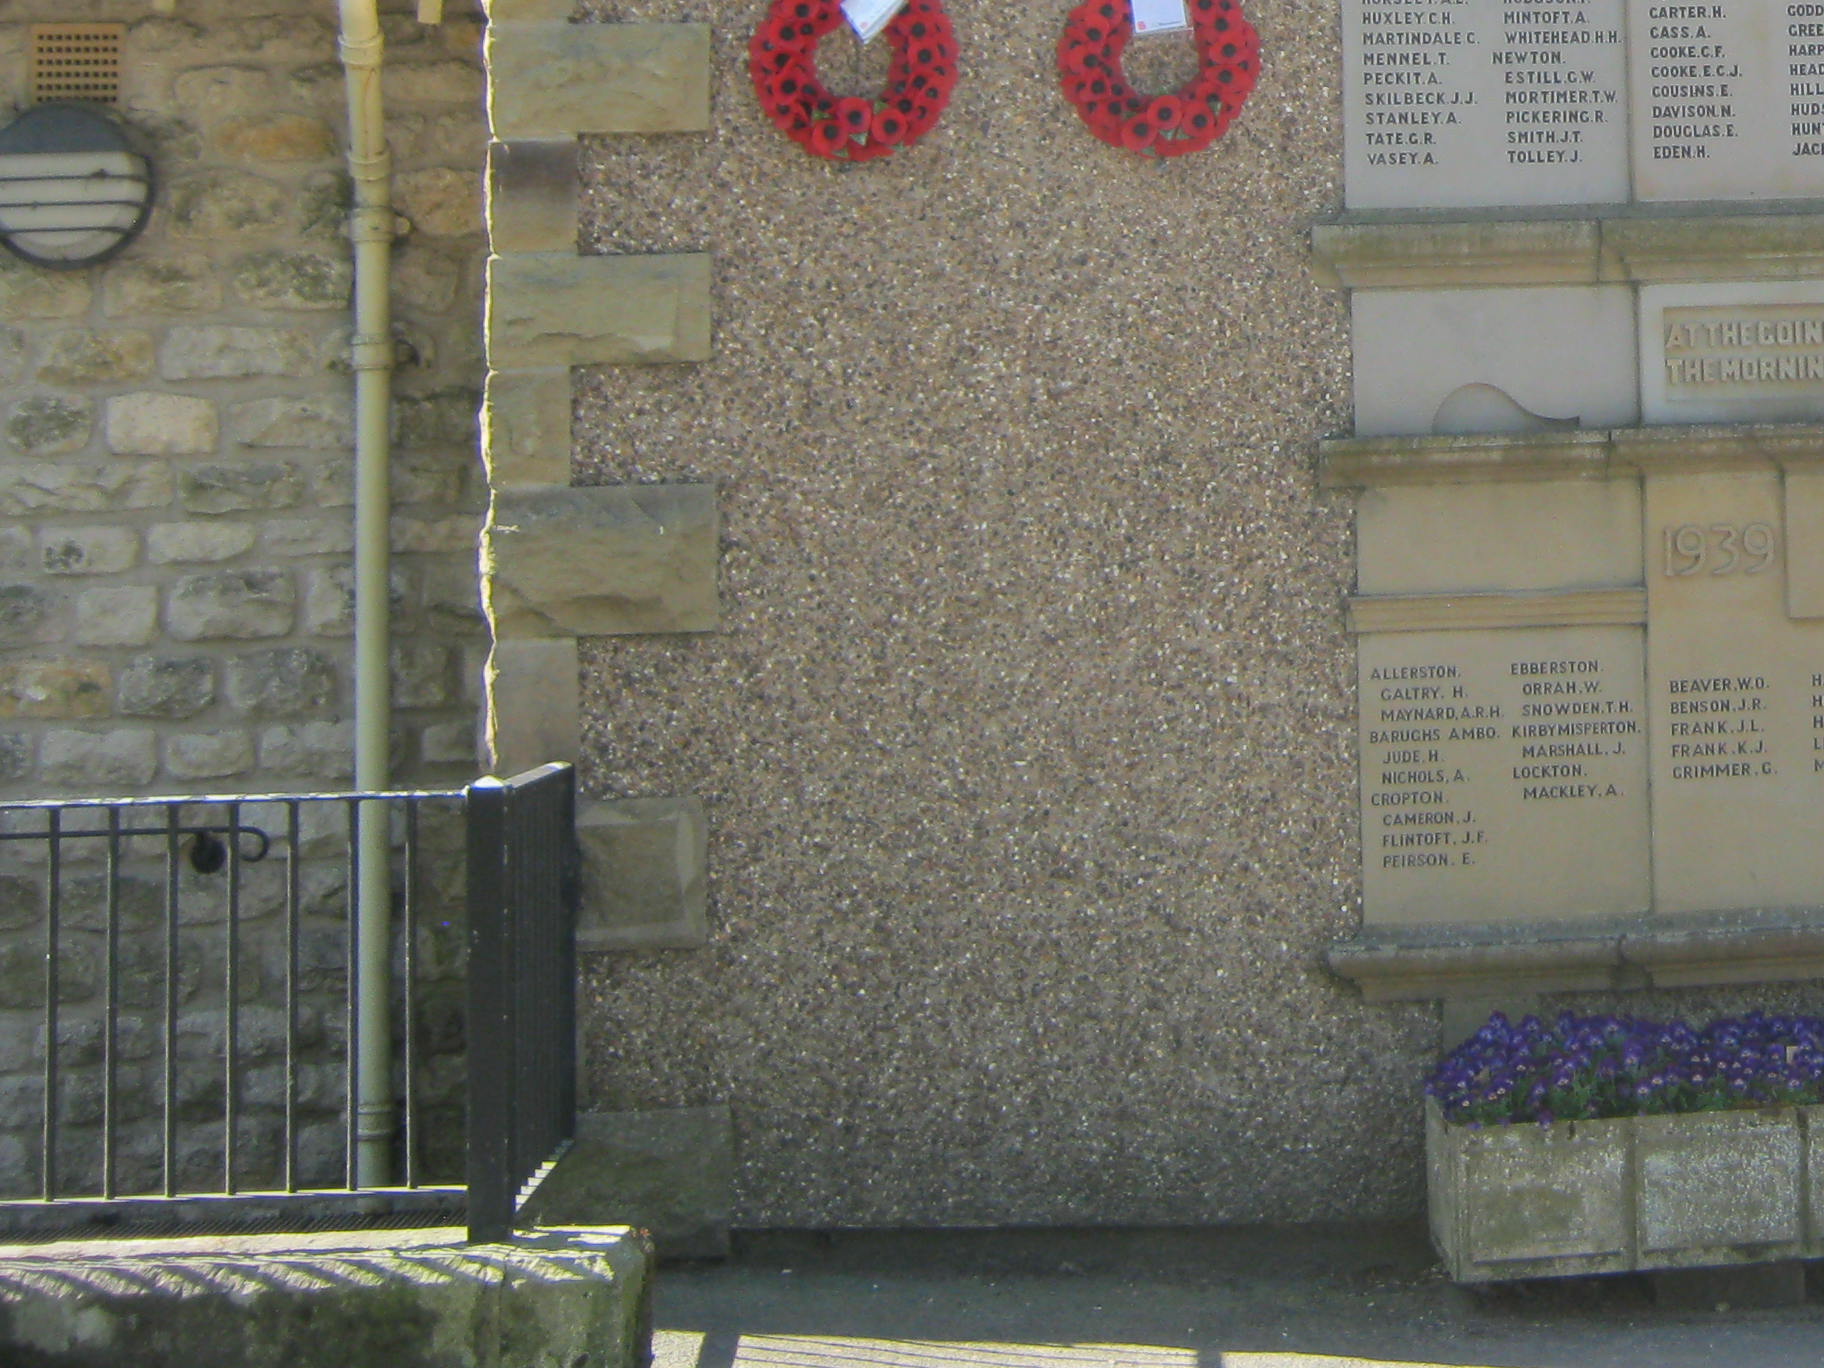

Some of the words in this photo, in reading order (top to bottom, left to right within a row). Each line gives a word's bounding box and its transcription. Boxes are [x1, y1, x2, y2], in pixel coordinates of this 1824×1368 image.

[1666, 323, 1697, 348] AT
[1703, 320, 1753, 346] THE
[1665, 357, 1713, 383] THE
[1664, 523, 1774, 576] 1939
[1370, 729, 1440, 744] BARUGHS
